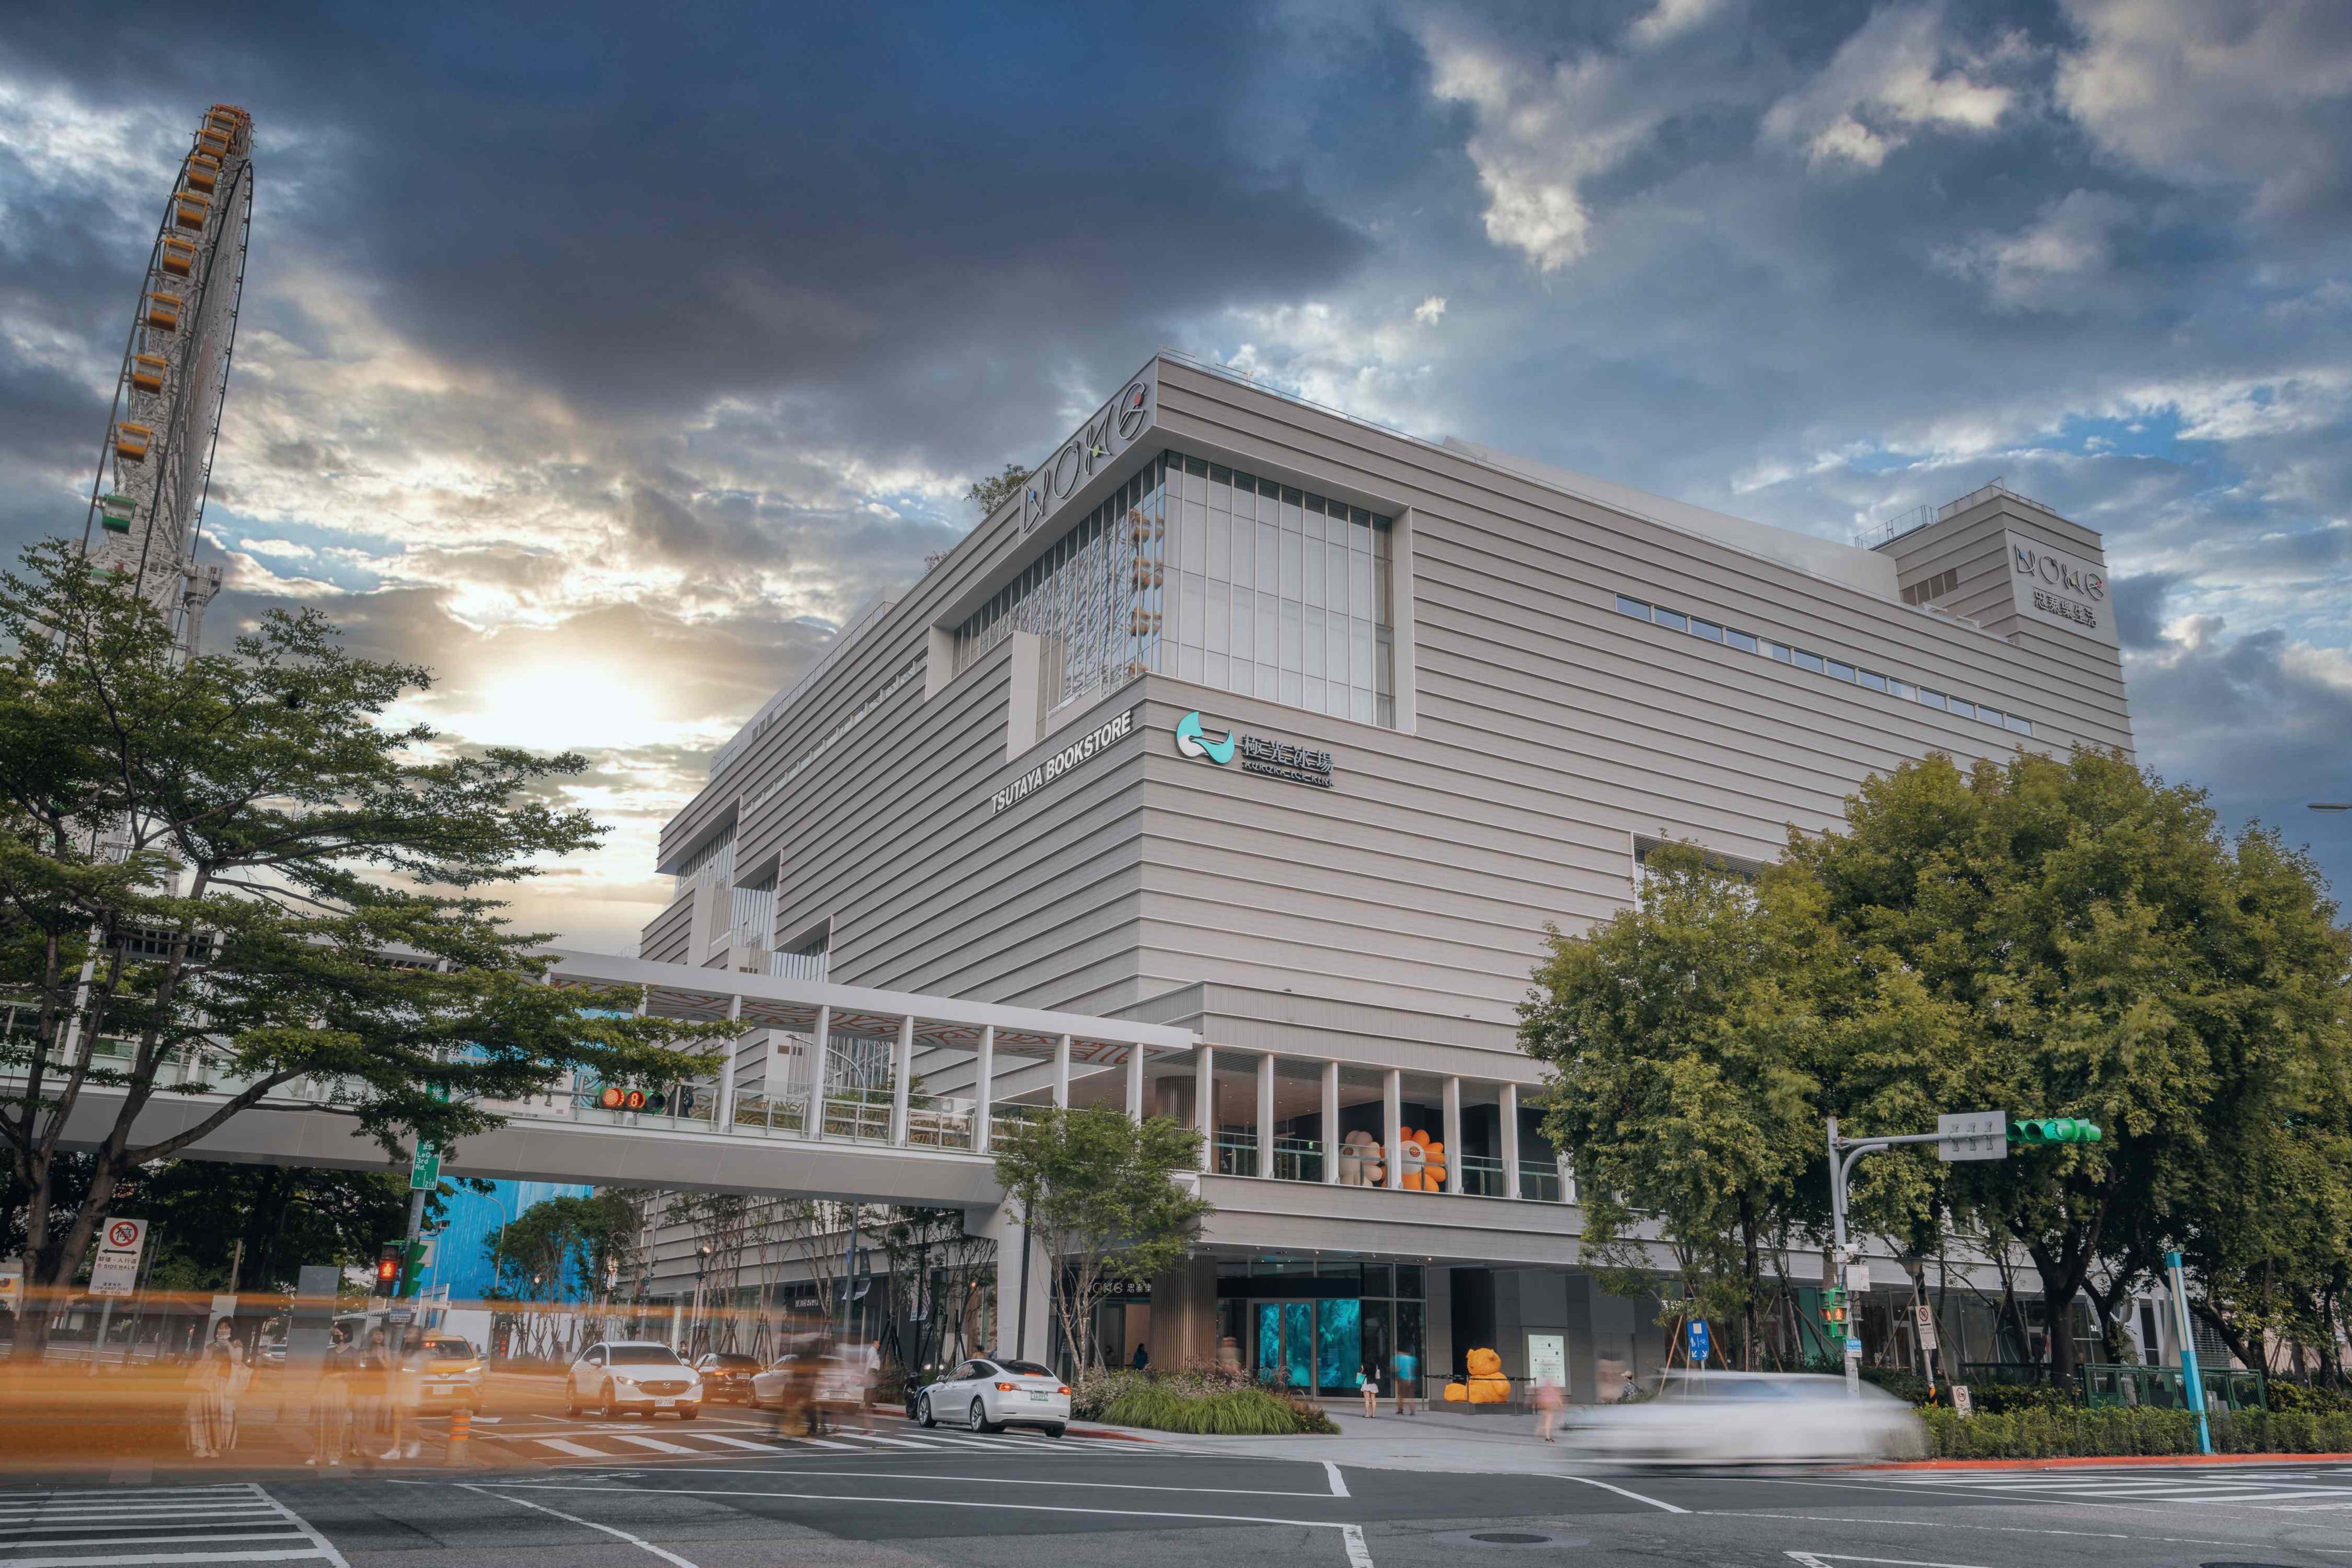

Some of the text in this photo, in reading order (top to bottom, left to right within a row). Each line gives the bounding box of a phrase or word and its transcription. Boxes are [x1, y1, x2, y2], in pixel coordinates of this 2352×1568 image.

[2034, 588, 2098, 628] 忠泰樂生活
[991, 709, 1134, 814] TSUTAYA BOOKSTORE
[1242, 734, 1334, 774] 極光冰場
[1244, 761, 1334, 787] AURORA ICE RINK
[115, 1226, 132, 1241] 停
